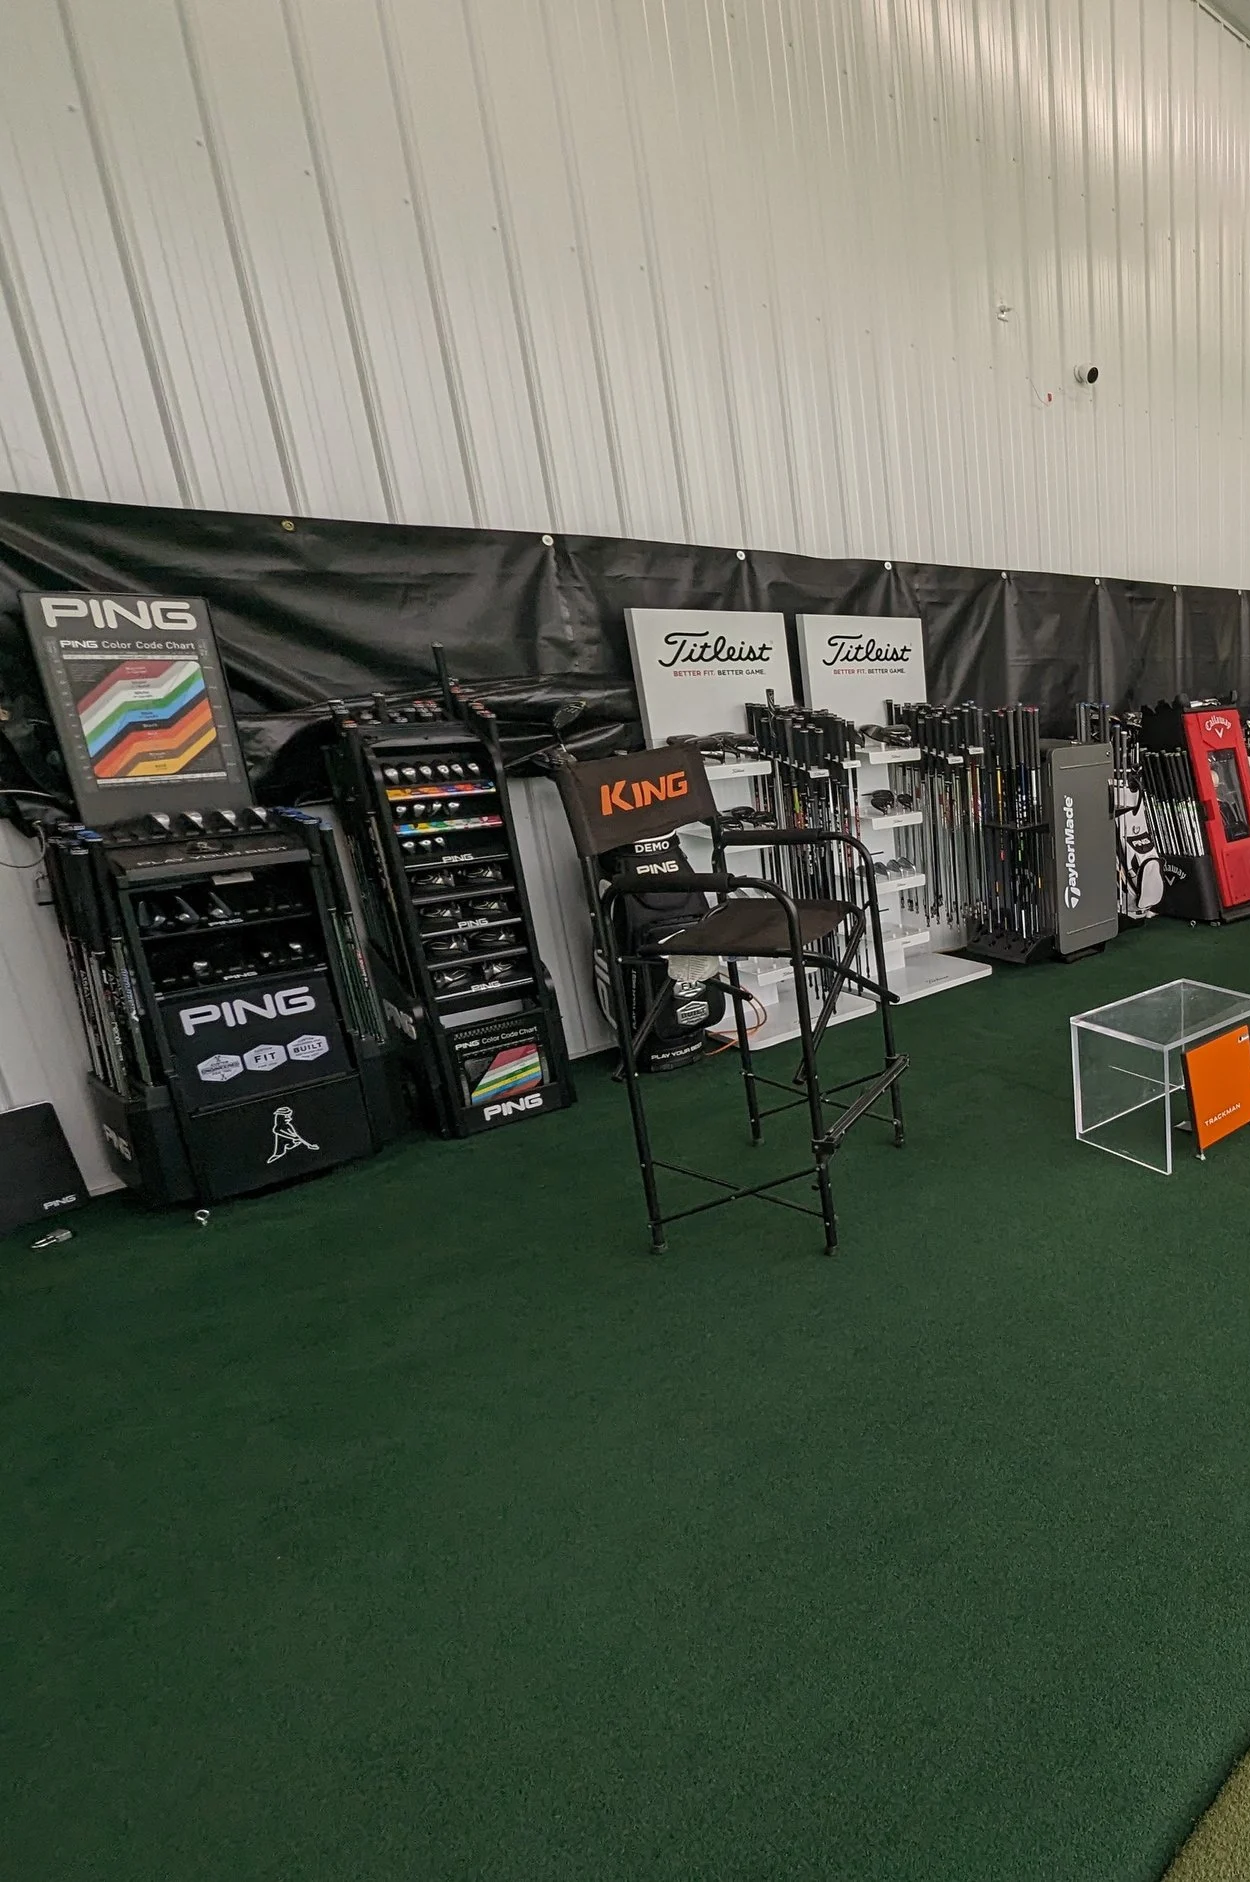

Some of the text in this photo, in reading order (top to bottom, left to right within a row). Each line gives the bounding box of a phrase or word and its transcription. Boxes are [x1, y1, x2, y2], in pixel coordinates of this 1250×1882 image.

[41, 598, 197, 630] PING
[60, 640, 195, 650] PING Color Code Chart
[658, 631, 772, 667] Titleist
[822, 634, 911, 666] Titleist
[1205, 715, 1232, 731] Callaway
[600, 771, 689, 816] KING
[634, 841, 670, 853] DEMO
[1064, 796, 1081, 909] TaylorMade
[442, 853, 474, 863] PING
[636, 860, 679, 874] PING
[458, 918, 489, 929] PING
[223, 972, 258, 980] PING
[471, 981, 500, 992] PING
[179, 986, 316, 1036] PING
[455, 1026, 538, 1050] PING Color Code Chart
[293, 1042, 323, 1053] BUILT
[671, 1048, 691, 1056] YOUR
[254, 1052, 276, 1063] FIT
[483, 1093, 543, 1121] PING
[1205, 1102, 1241, 1126] TRACKMAN
[43, 1194, 77, 1210] PING
